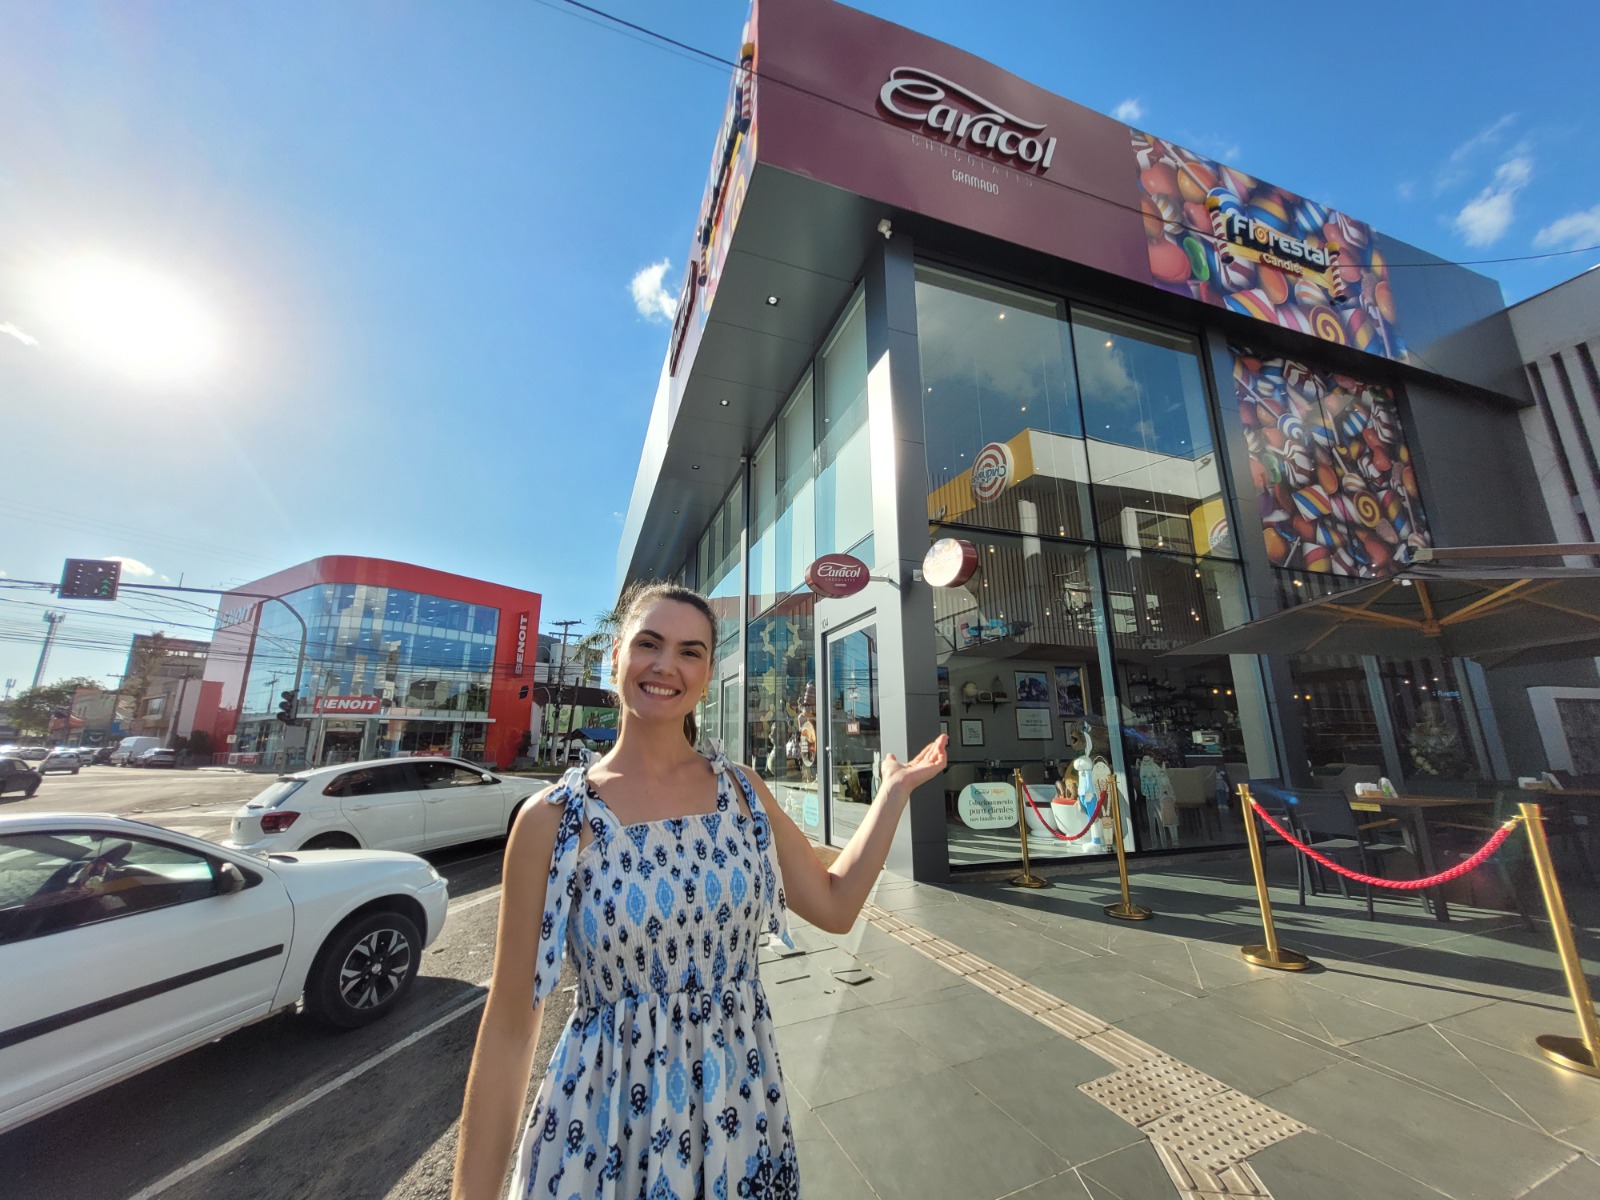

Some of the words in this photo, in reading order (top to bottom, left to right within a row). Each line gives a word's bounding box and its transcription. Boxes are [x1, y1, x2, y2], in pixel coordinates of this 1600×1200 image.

[880, 66, 1057, 168] Caracol
[951, 169, 999, 195] GRAMADO
[1232, 213, 1331, 267] Florestal
[1261, 252, 1305, 275] Candies
[817, 561, 862, 578] Caracol
[821, 618, 829, 629] 104
[514, 614, 528, 675] BENOIT
[969, 808, 986, 816] para
[987, 806, 1014, 814] clientes
